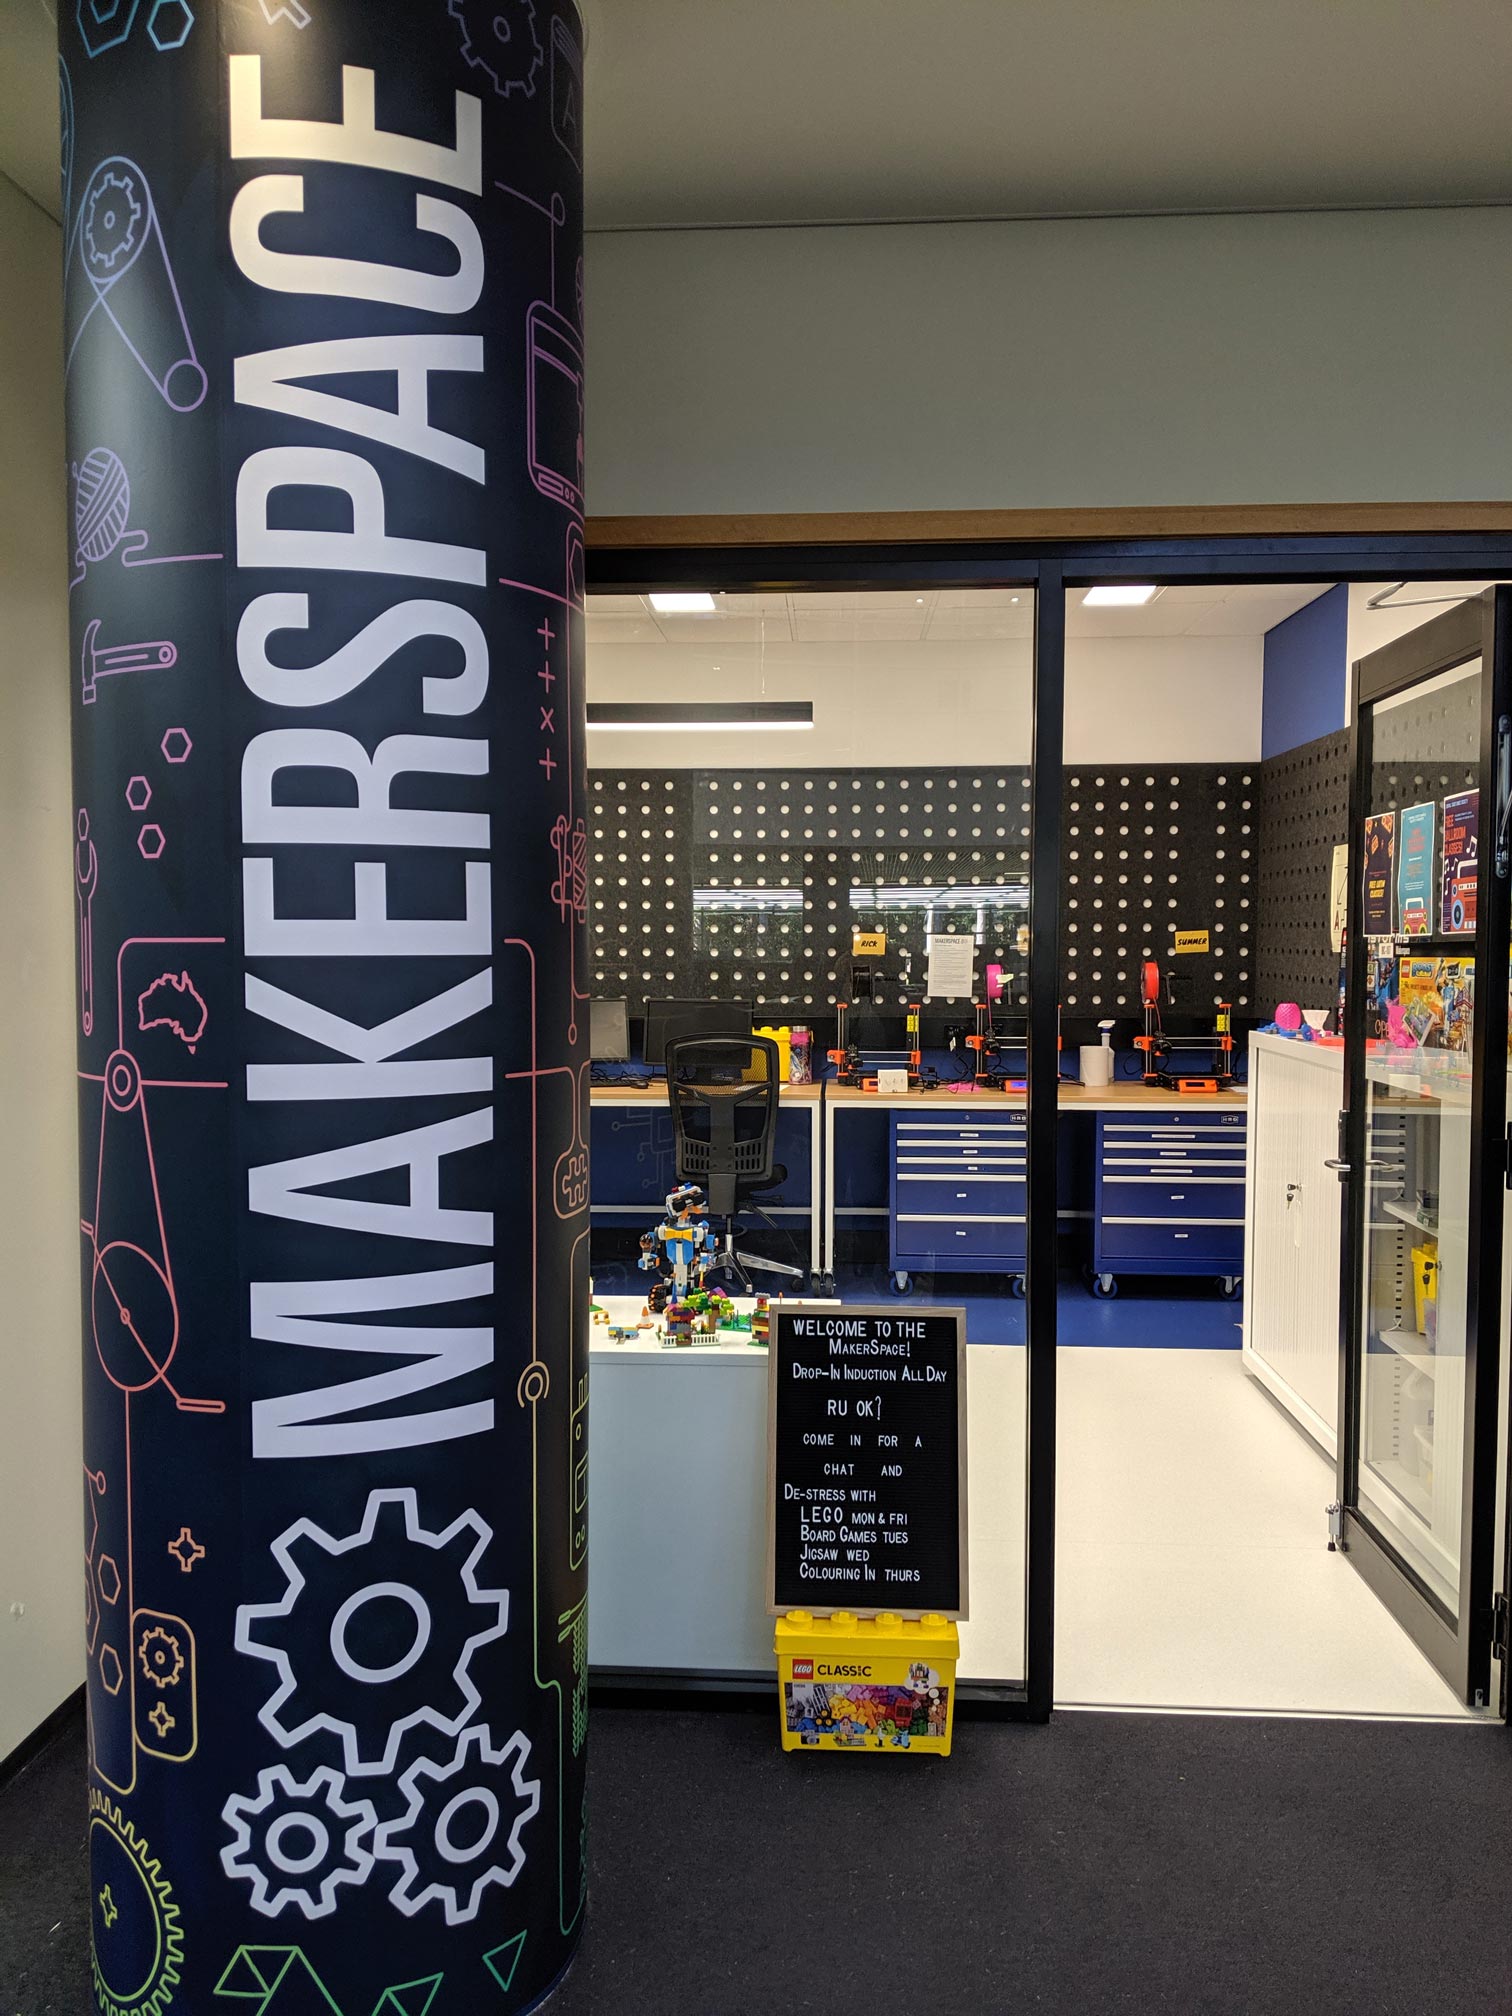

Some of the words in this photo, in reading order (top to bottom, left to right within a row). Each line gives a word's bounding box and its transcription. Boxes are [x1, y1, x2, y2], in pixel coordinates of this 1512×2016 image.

[227, 53, 495, 1459] MAKERSPACE
[1177, 937, 1208, 946] SUMMER
[793, 1319, 867, 1337] WELCOME
[874, 1321, 892, 1338] TO
[896, 1321, 926, 1338] THE
[844, 1363, 897, 1381] INDUCTION
[901, 1365, 924, 1382] ALL
[926, 1366, 948, 1382] DAY
[827, 1400, 848, 1416] RU
[856, 1395, 882, 1421] OK?
[803, 1433, 835, 1446] COME
[850, 1435, 862, 1446] IN
[878, 1435, 899, 1447] FOR
[914, 1436, 922, 1448] A
[823, 1463, 854, 1476] CHAT
[880, 1465, 903, 1477] AND
[850, 1489, 876, 1502] WITH
[800, 1506, 843, 1523] LEGO
[851, 1513, 875, 1525] MON
[878, 1513, 886, 1525] &
[889, 1514, 908, 1525] FRI
[800, 1526, 836, 1542] BOARD
[839, 1526, 877, 1543] GAMES
[882, 1531, 909, 1544] TUES
[800, 1544, 838, 1561] JIGSAW
[846, 1549, 870, 1562] WED
[884, 1569, 921, 1582] THURS
[794, 1664, 812, 1674] LEGO
[817, 1663, 872, 1677] CLASSIC
